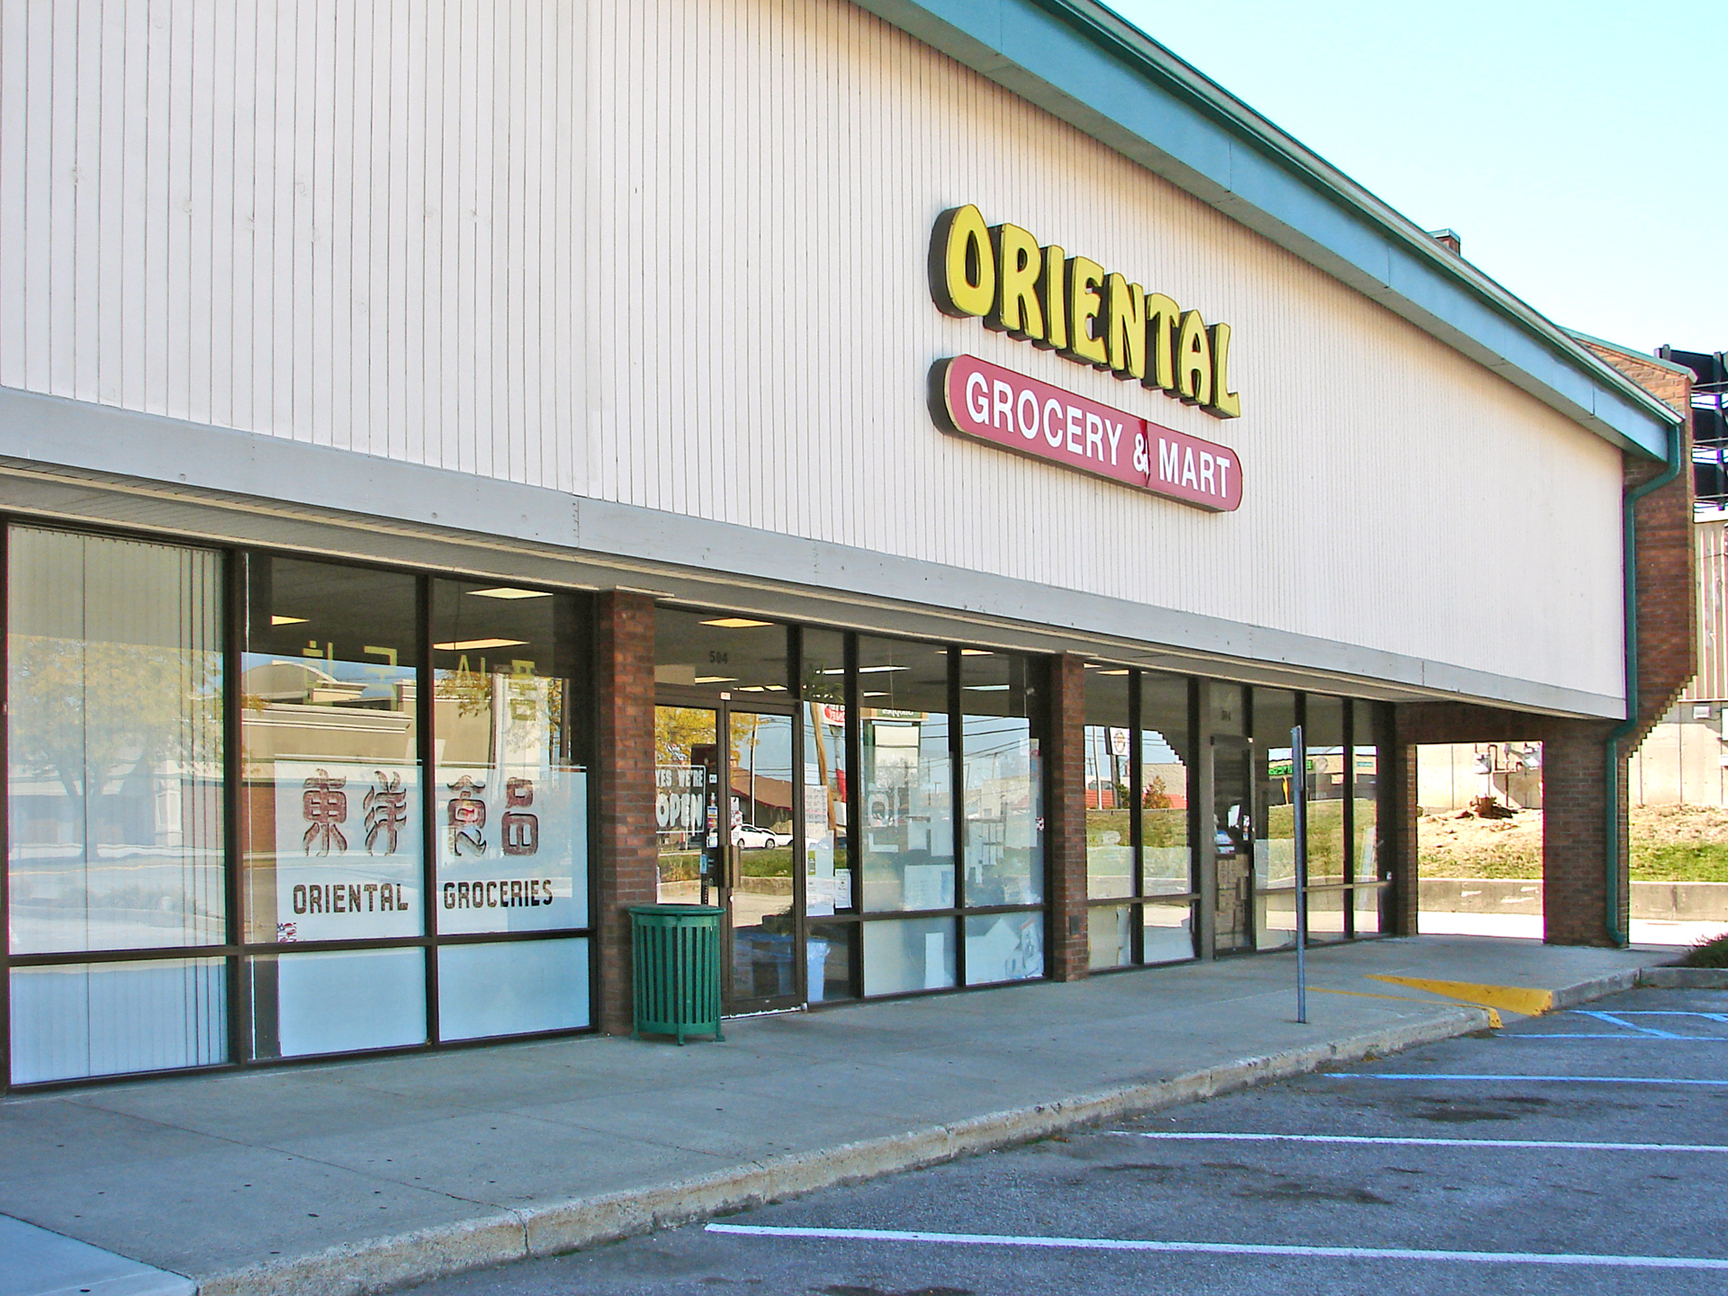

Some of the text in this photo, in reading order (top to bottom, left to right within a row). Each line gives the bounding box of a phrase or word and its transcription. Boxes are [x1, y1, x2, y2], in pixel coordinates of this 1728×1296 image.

[943, 203, 1241, 418] ORIENTAL
[965, 371, 1231, 498] GROCERY & MART
[709, 650, 728, 665] 504
[655, 768, 704, 788] YES WE'RE
[656, 793, 703, 828] OPEN
[292, 879, 554, 915] ORIENTAL GROCERIES
